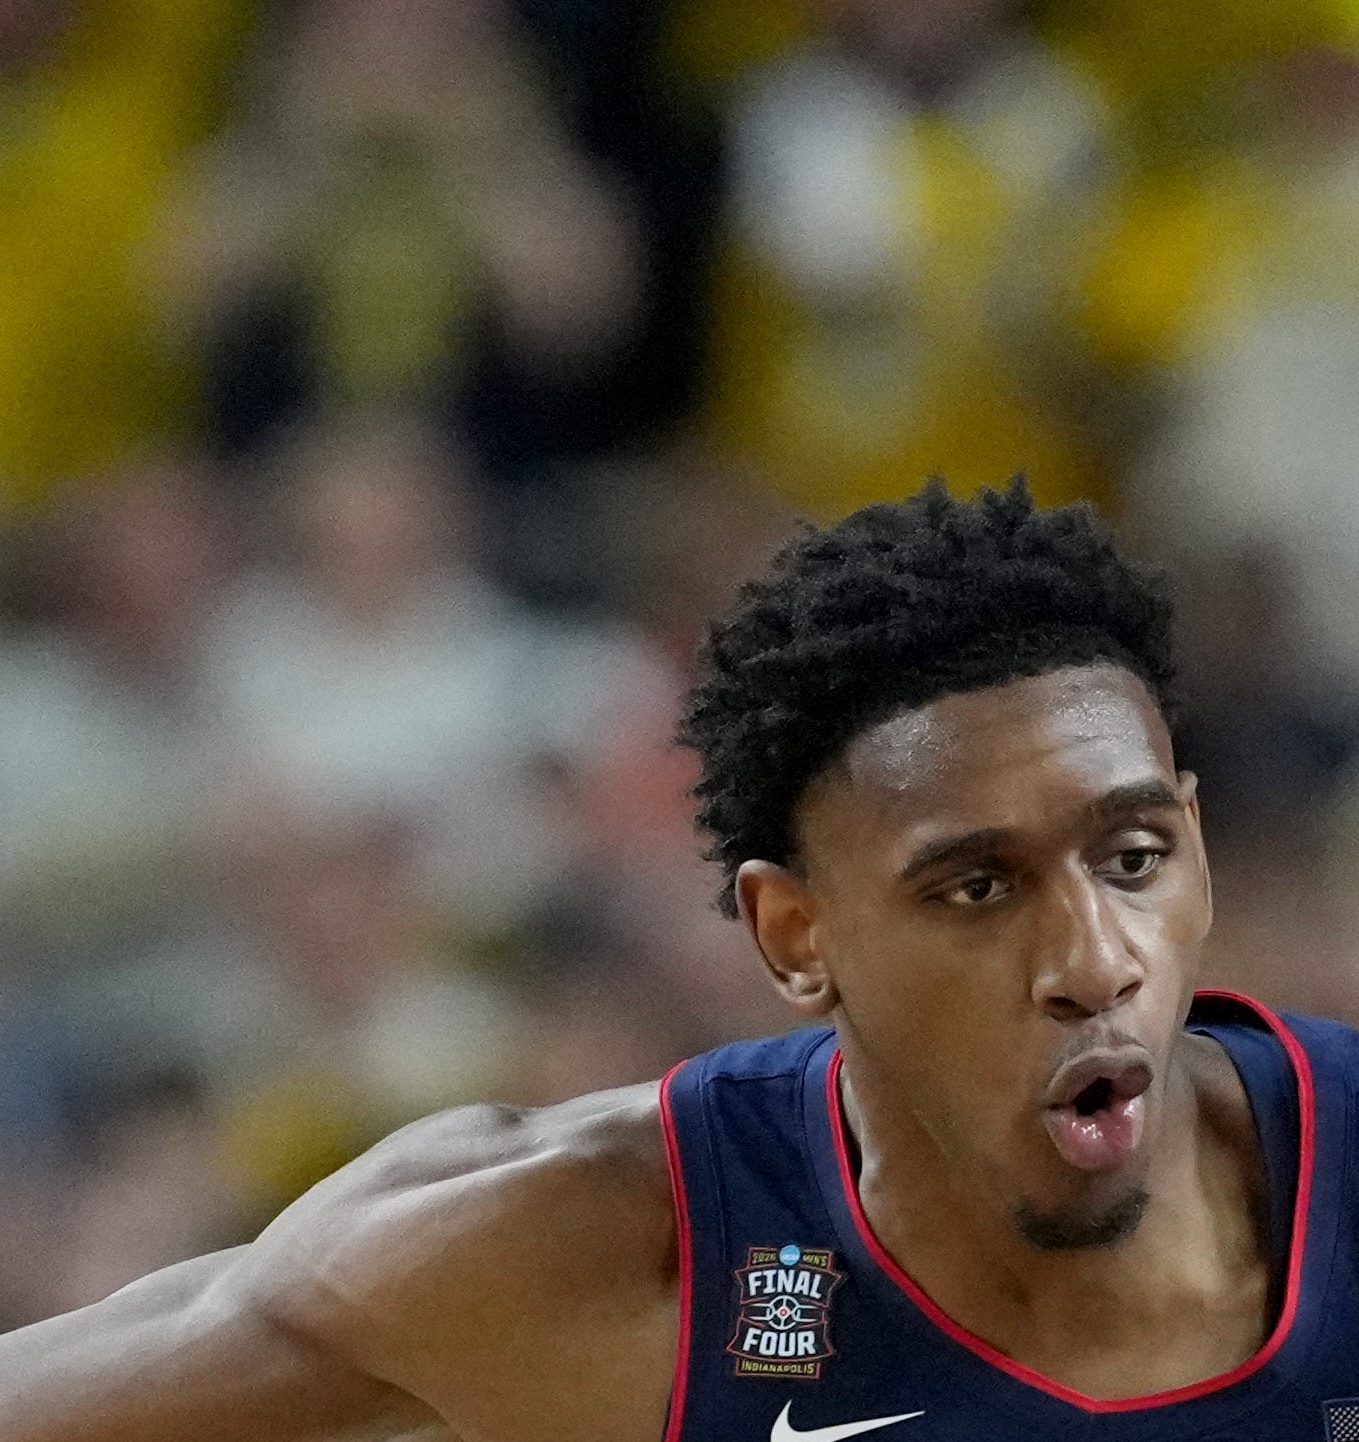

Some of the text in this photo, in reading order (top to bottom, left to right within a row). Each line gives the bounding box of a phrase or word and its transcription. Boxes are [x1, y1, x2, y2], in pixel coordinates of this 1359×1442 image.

[748, 1269, 822, 1299] FINAL
[742, 1328, 816, 1357] FOUR
[742, 1360, 815, 1374] INDIANAPOLIS
